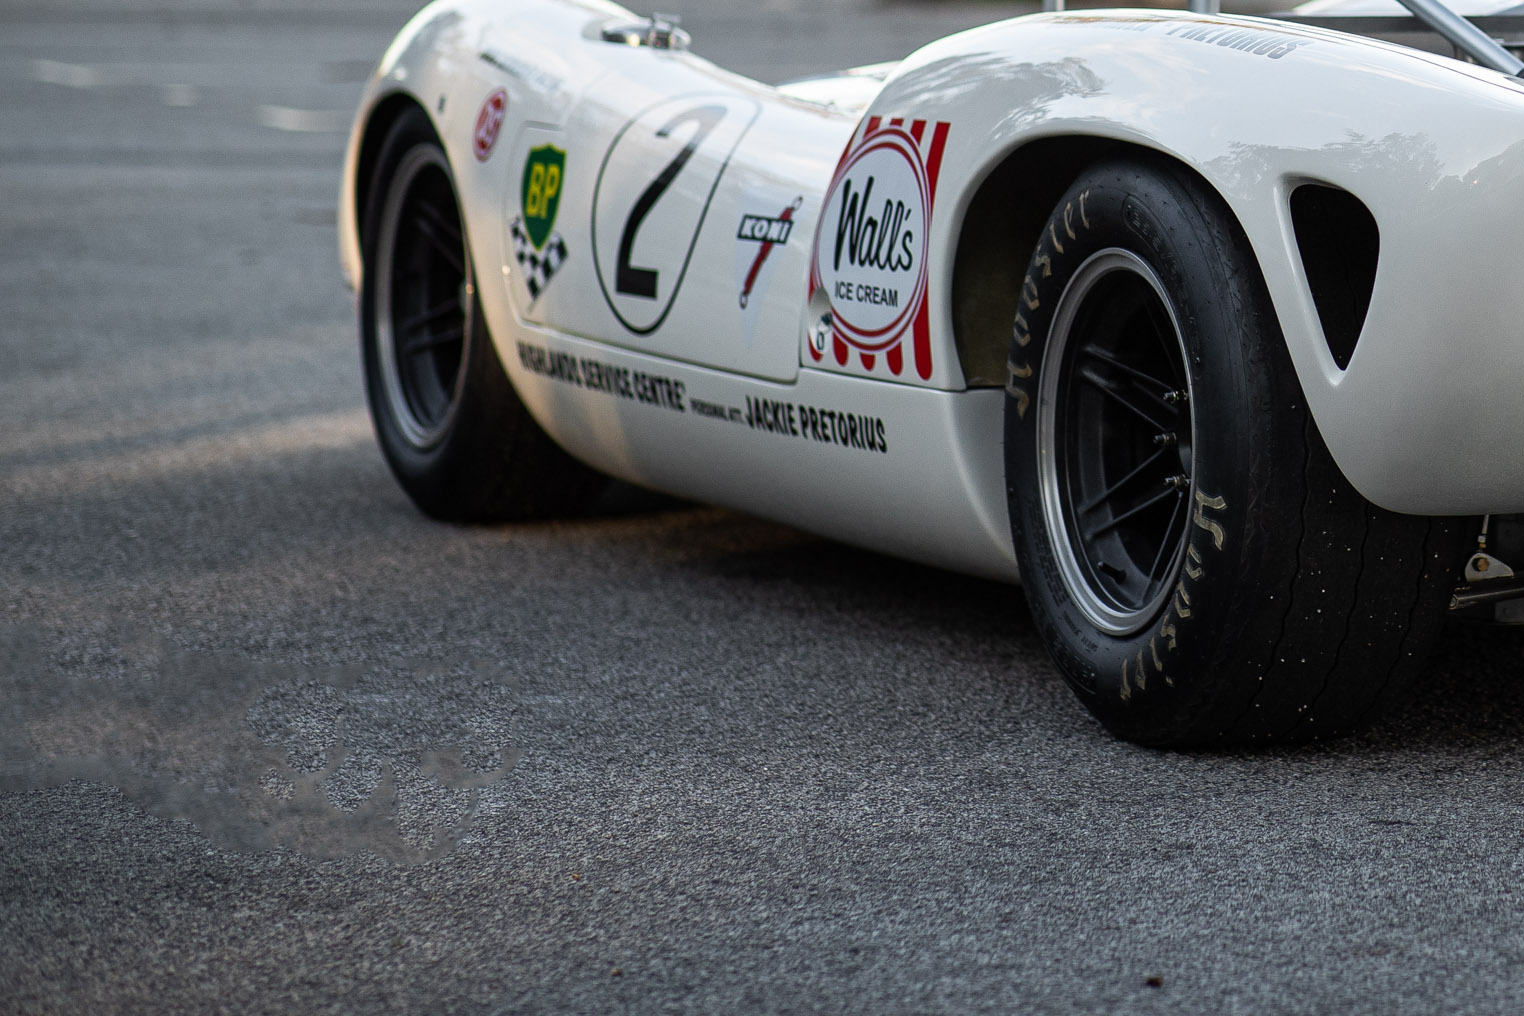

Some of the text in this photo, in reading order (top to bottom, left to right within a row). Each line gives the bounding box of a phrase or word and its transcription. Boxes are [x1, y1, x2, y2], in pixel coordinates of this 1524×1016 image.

[526, 162, 560, 219] BP
[616, 104, 728, 301] 2
[834, 175, 913, 272] Wall's
[741, 218, 790, 241] KONI
[835, 281, 899, 307] ICE CREAM
[579, 356, 634, 400] SERVICE
[746, 394, 798, 436] JACKIE
[798, 404, 887, 454] PRETORIUS
